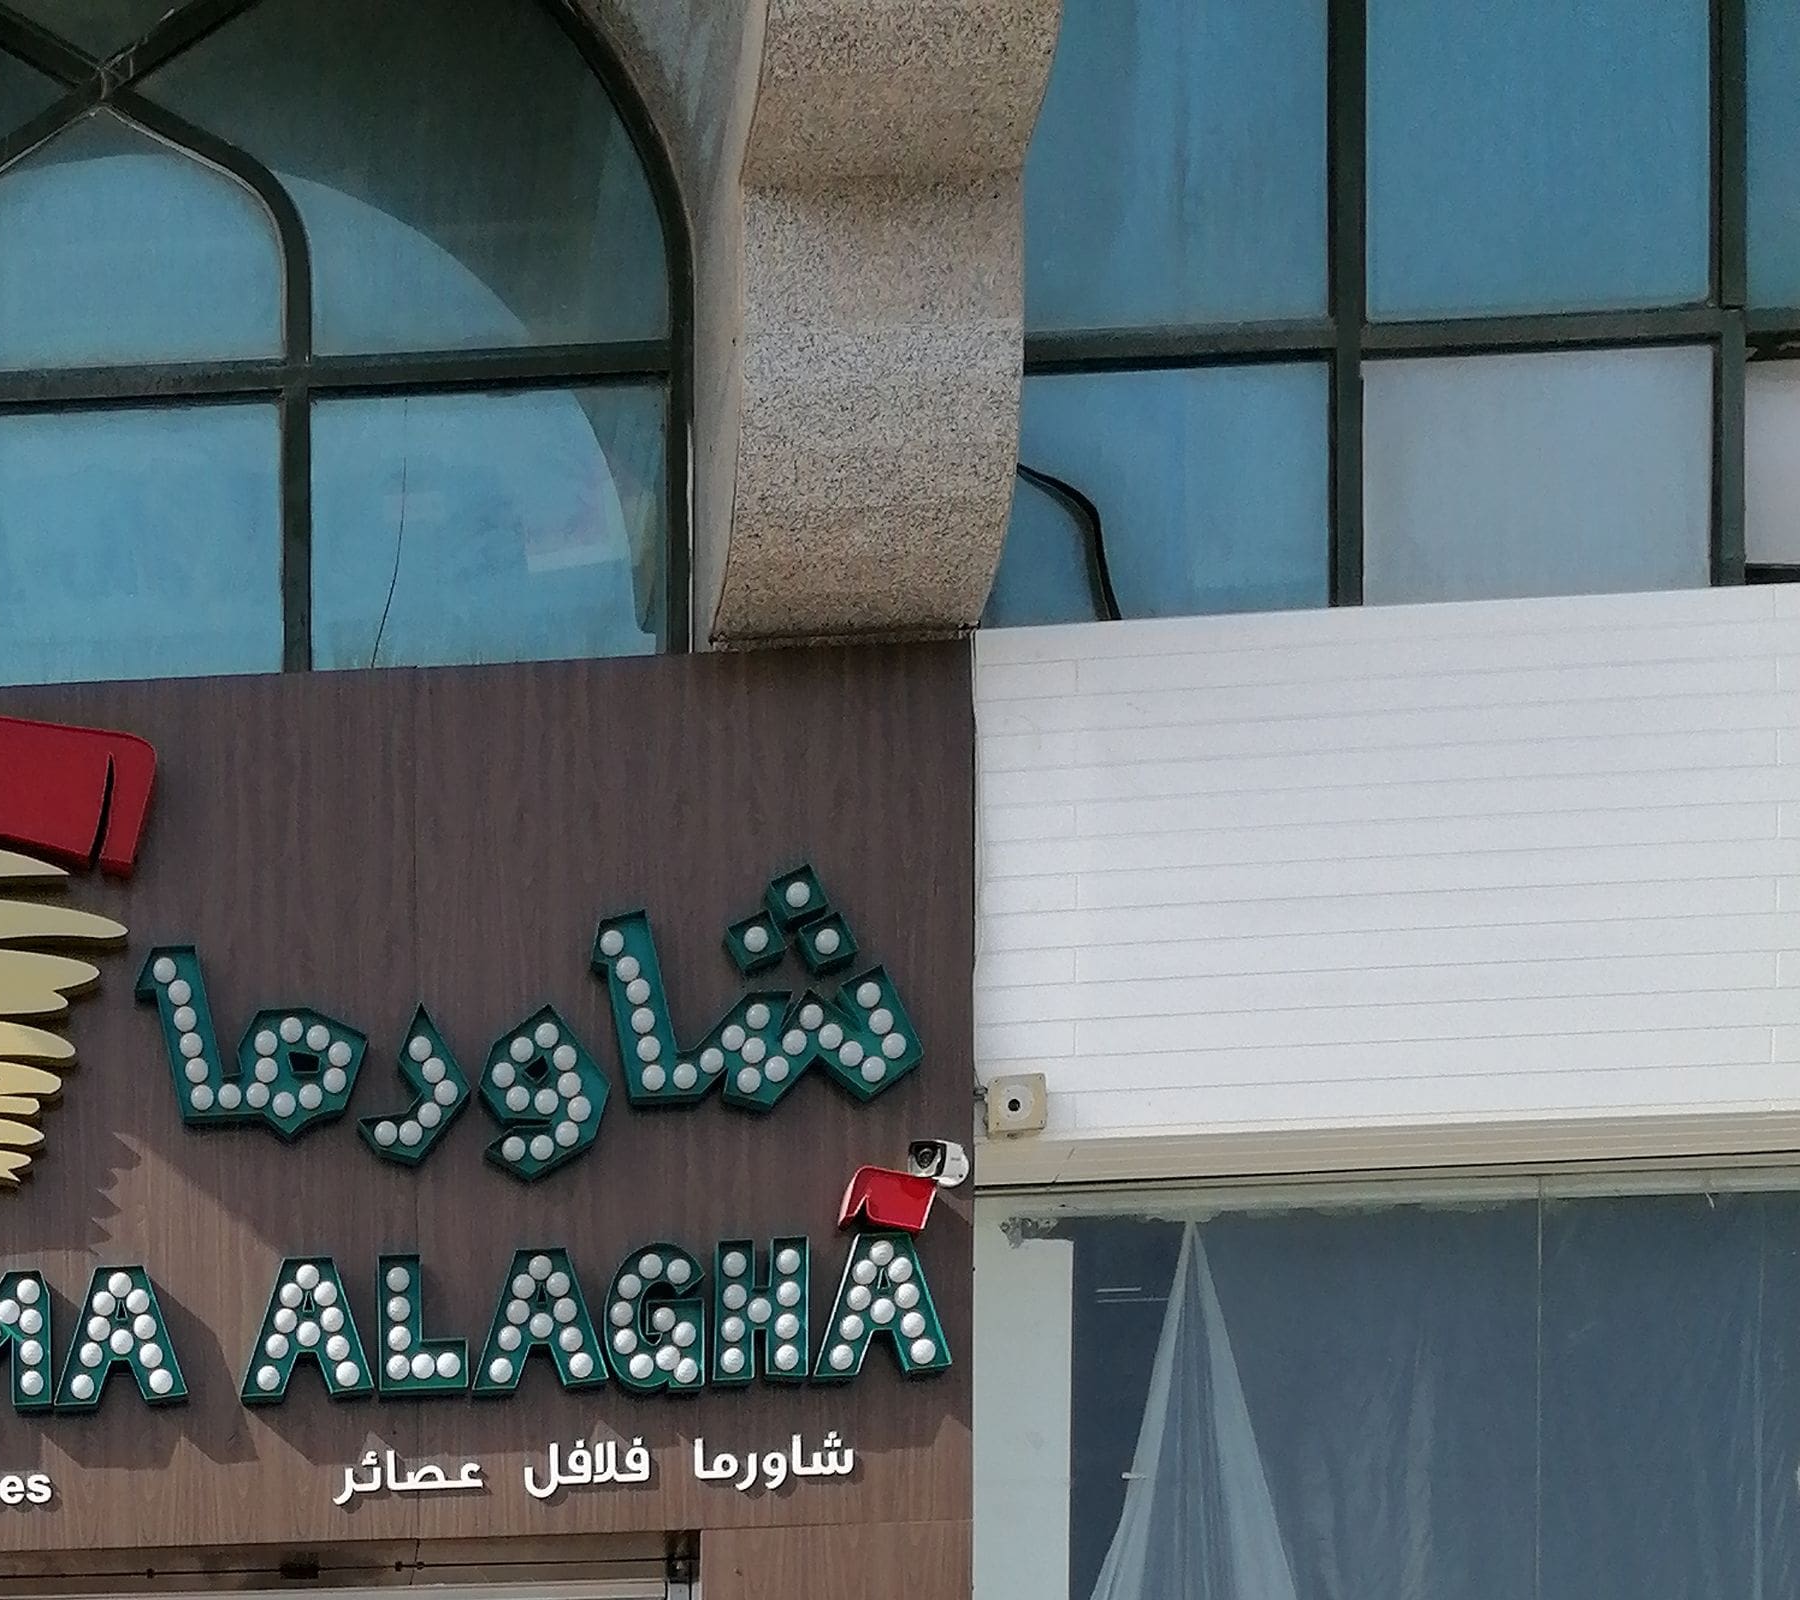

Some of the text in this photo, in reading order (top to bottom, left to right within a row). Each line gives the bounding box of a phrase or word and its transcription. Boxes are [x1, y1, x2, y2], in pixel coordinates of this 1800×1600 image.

[135, 865, 924, 1181] شاورما
[240, 1232, 952, 1407] ALAGHA
[332, 1431, 854, 1506] شاورما فلافل عصائر
